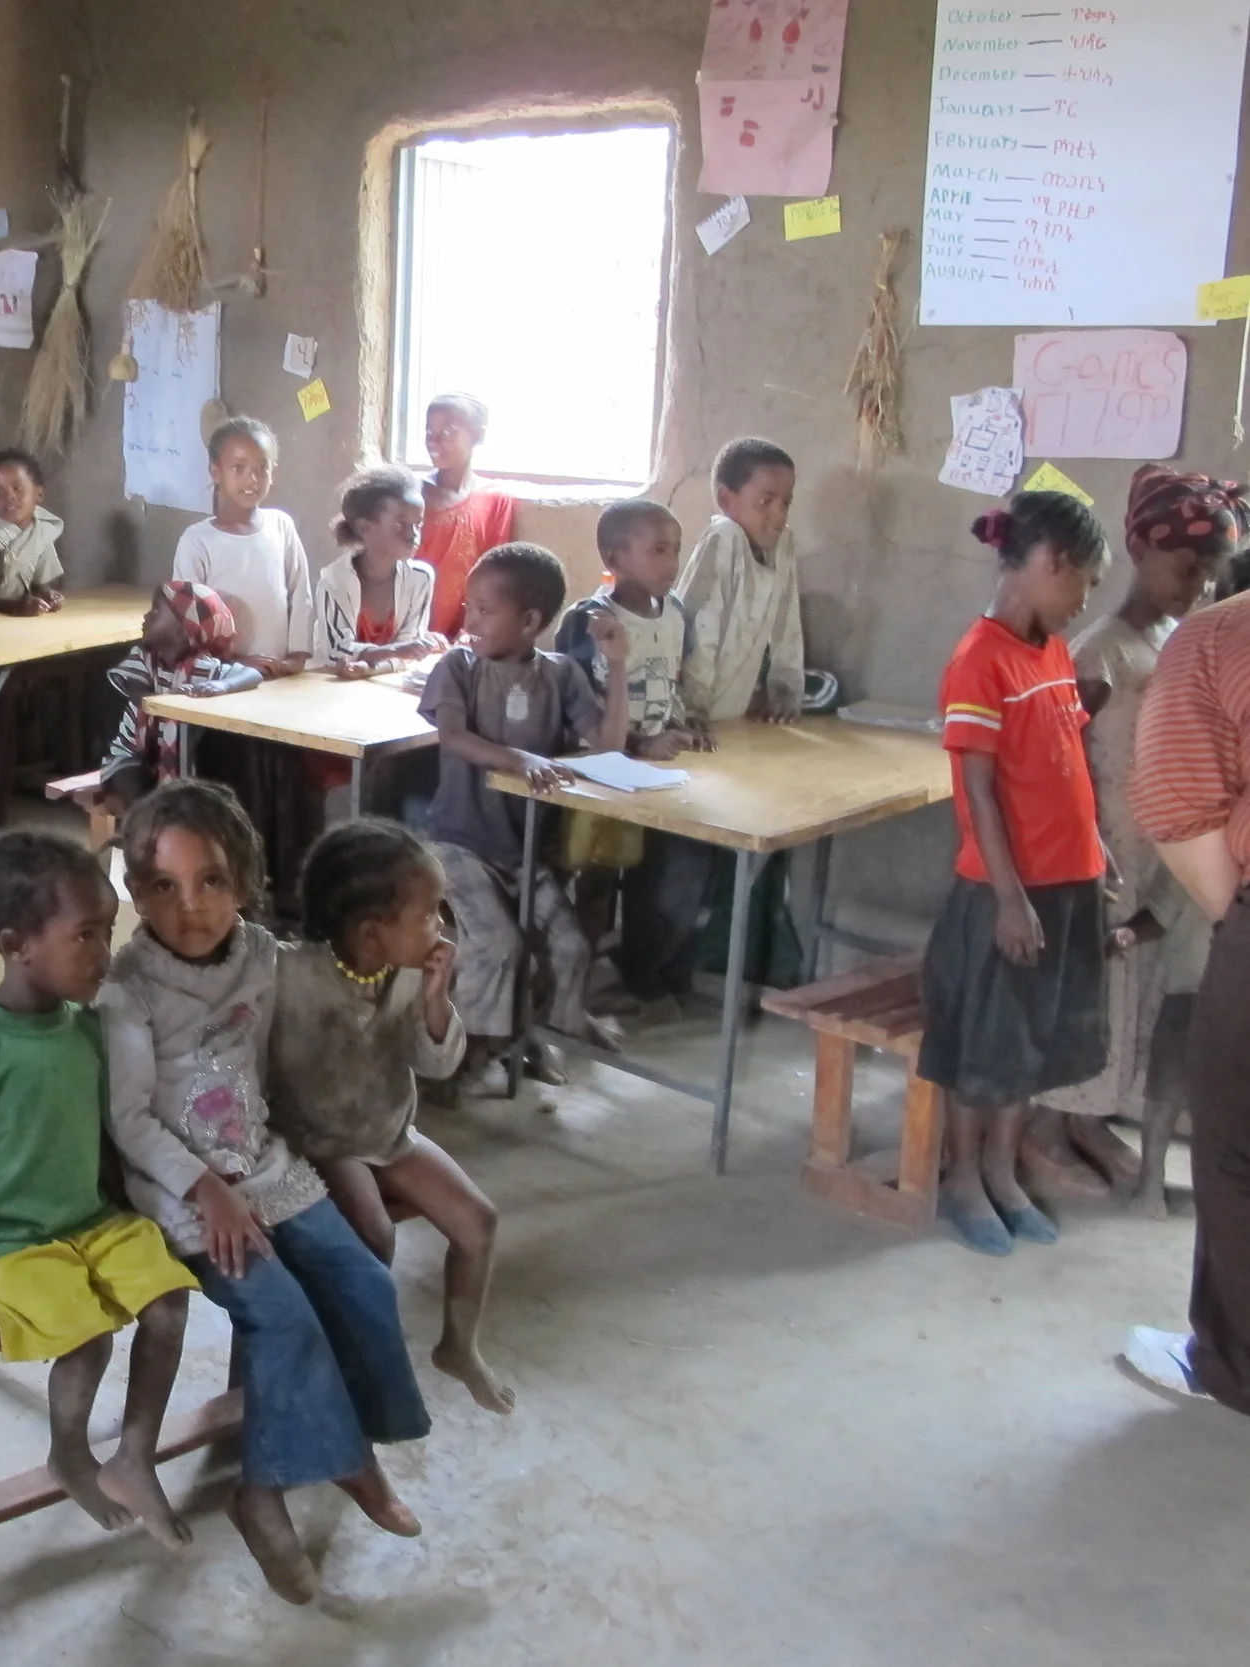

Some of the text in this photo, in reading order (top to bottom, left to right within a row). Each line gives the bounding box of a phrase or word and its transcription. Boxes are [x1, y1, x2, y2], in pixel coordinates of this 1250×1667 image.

[942, 37, 1019, 51] November
[939, 65, 1017, 81] December
[937, 96, 1015, 116] January
[934, 131, 1018, 151] February
[932, 163, 999, 184] March
[926, 207, 964, 223] May
[928, 226, 965, 245] June
